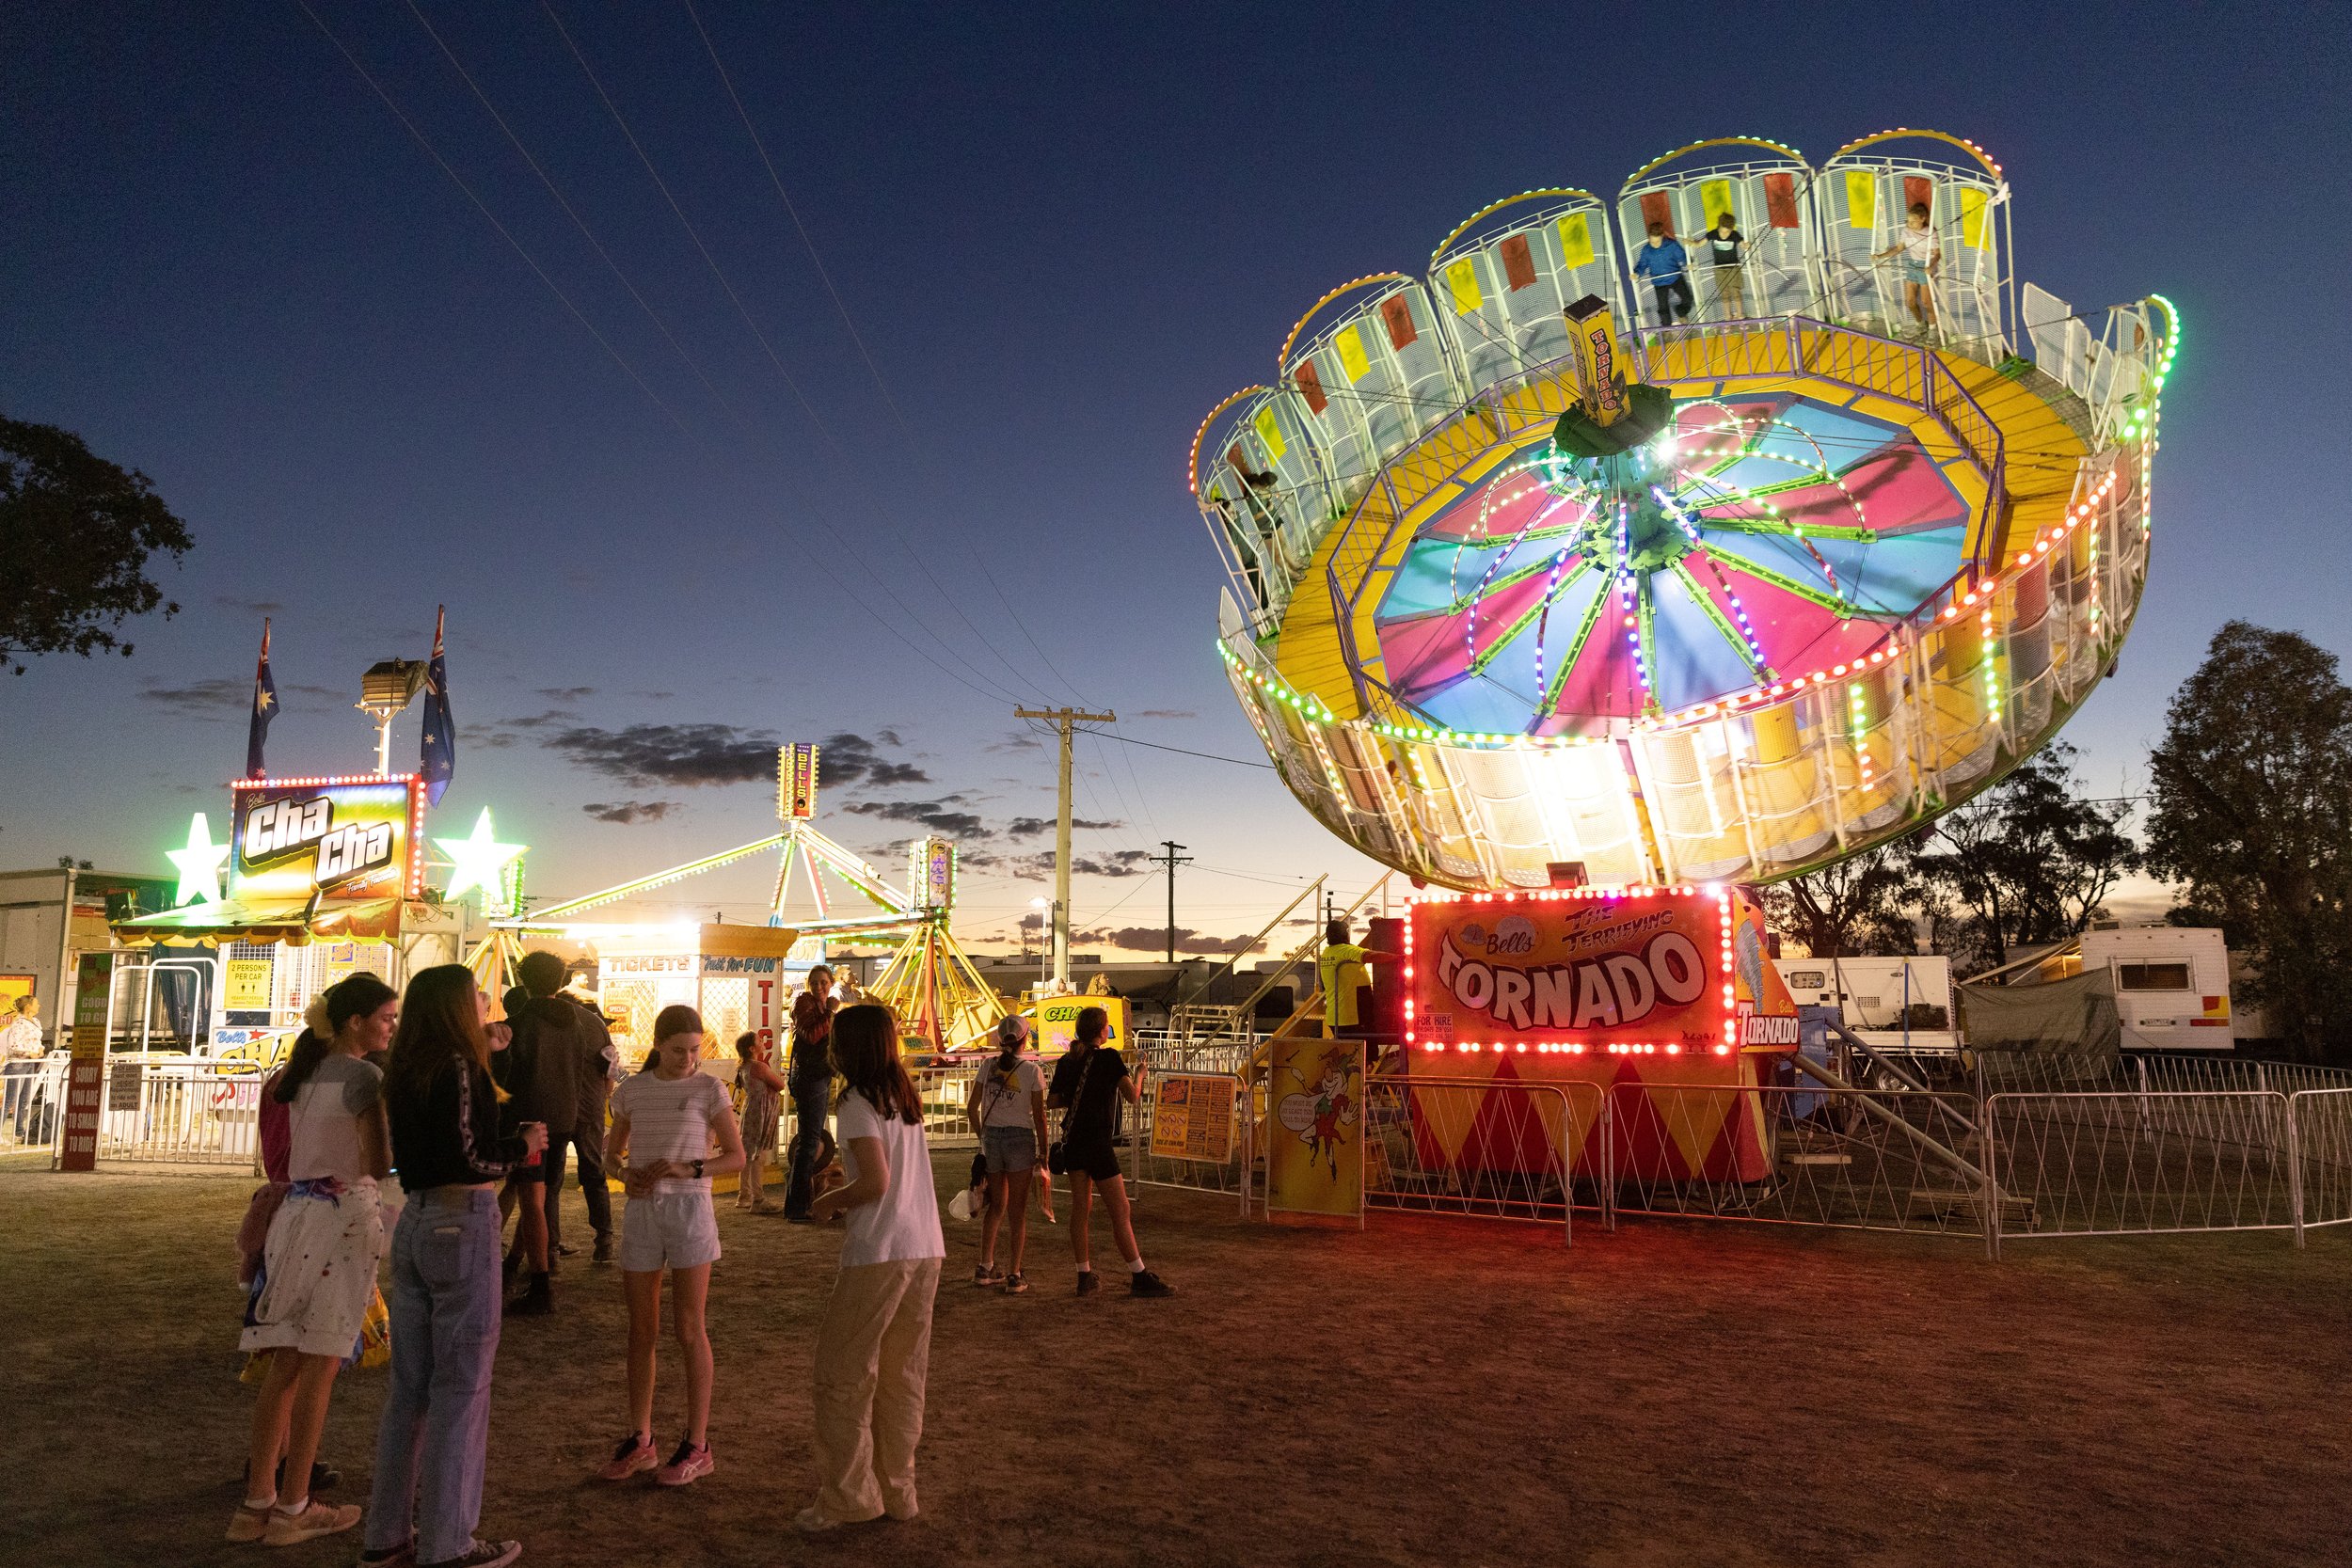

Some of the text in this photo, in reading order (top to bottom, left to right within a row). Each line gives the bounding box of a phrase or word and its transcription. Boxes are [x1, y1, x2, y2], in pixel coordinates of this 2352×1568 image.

[1590, 329, 1617, 410] TORNADO
[797, 752, 808, 799] BELLS
[244, 797, 330, 860] Cha
[314, 822, 391, 883] Cha
[1565, 905, 1616, 930] THE
[1562, 909, 1675, 953] TERRIFYING
[1486, 930, 1535, 955] Bells
[609, 956, 691, 972] TICKETS
[704, 955, 776, 973] Just for FUN
[1438, 928, 1707, 1031] TORNADO
[82, 997, 107, 1008] GOOD
[80, 1012, 106, 1023] TO GO
[1417, 1016, 1452, 1025] FOR HIRE
[1738, 1002, 1799, 1046] TORNADO
[215, 1030, 246, 1044] Bells
[76, 1067, 99, 1083] SORRY
[72, 1090, 99, 1106] YOU ARE
[68, 1113, 99, 1130] TO SMALL
[70, 1135, 94, 1152] TO RIDE
